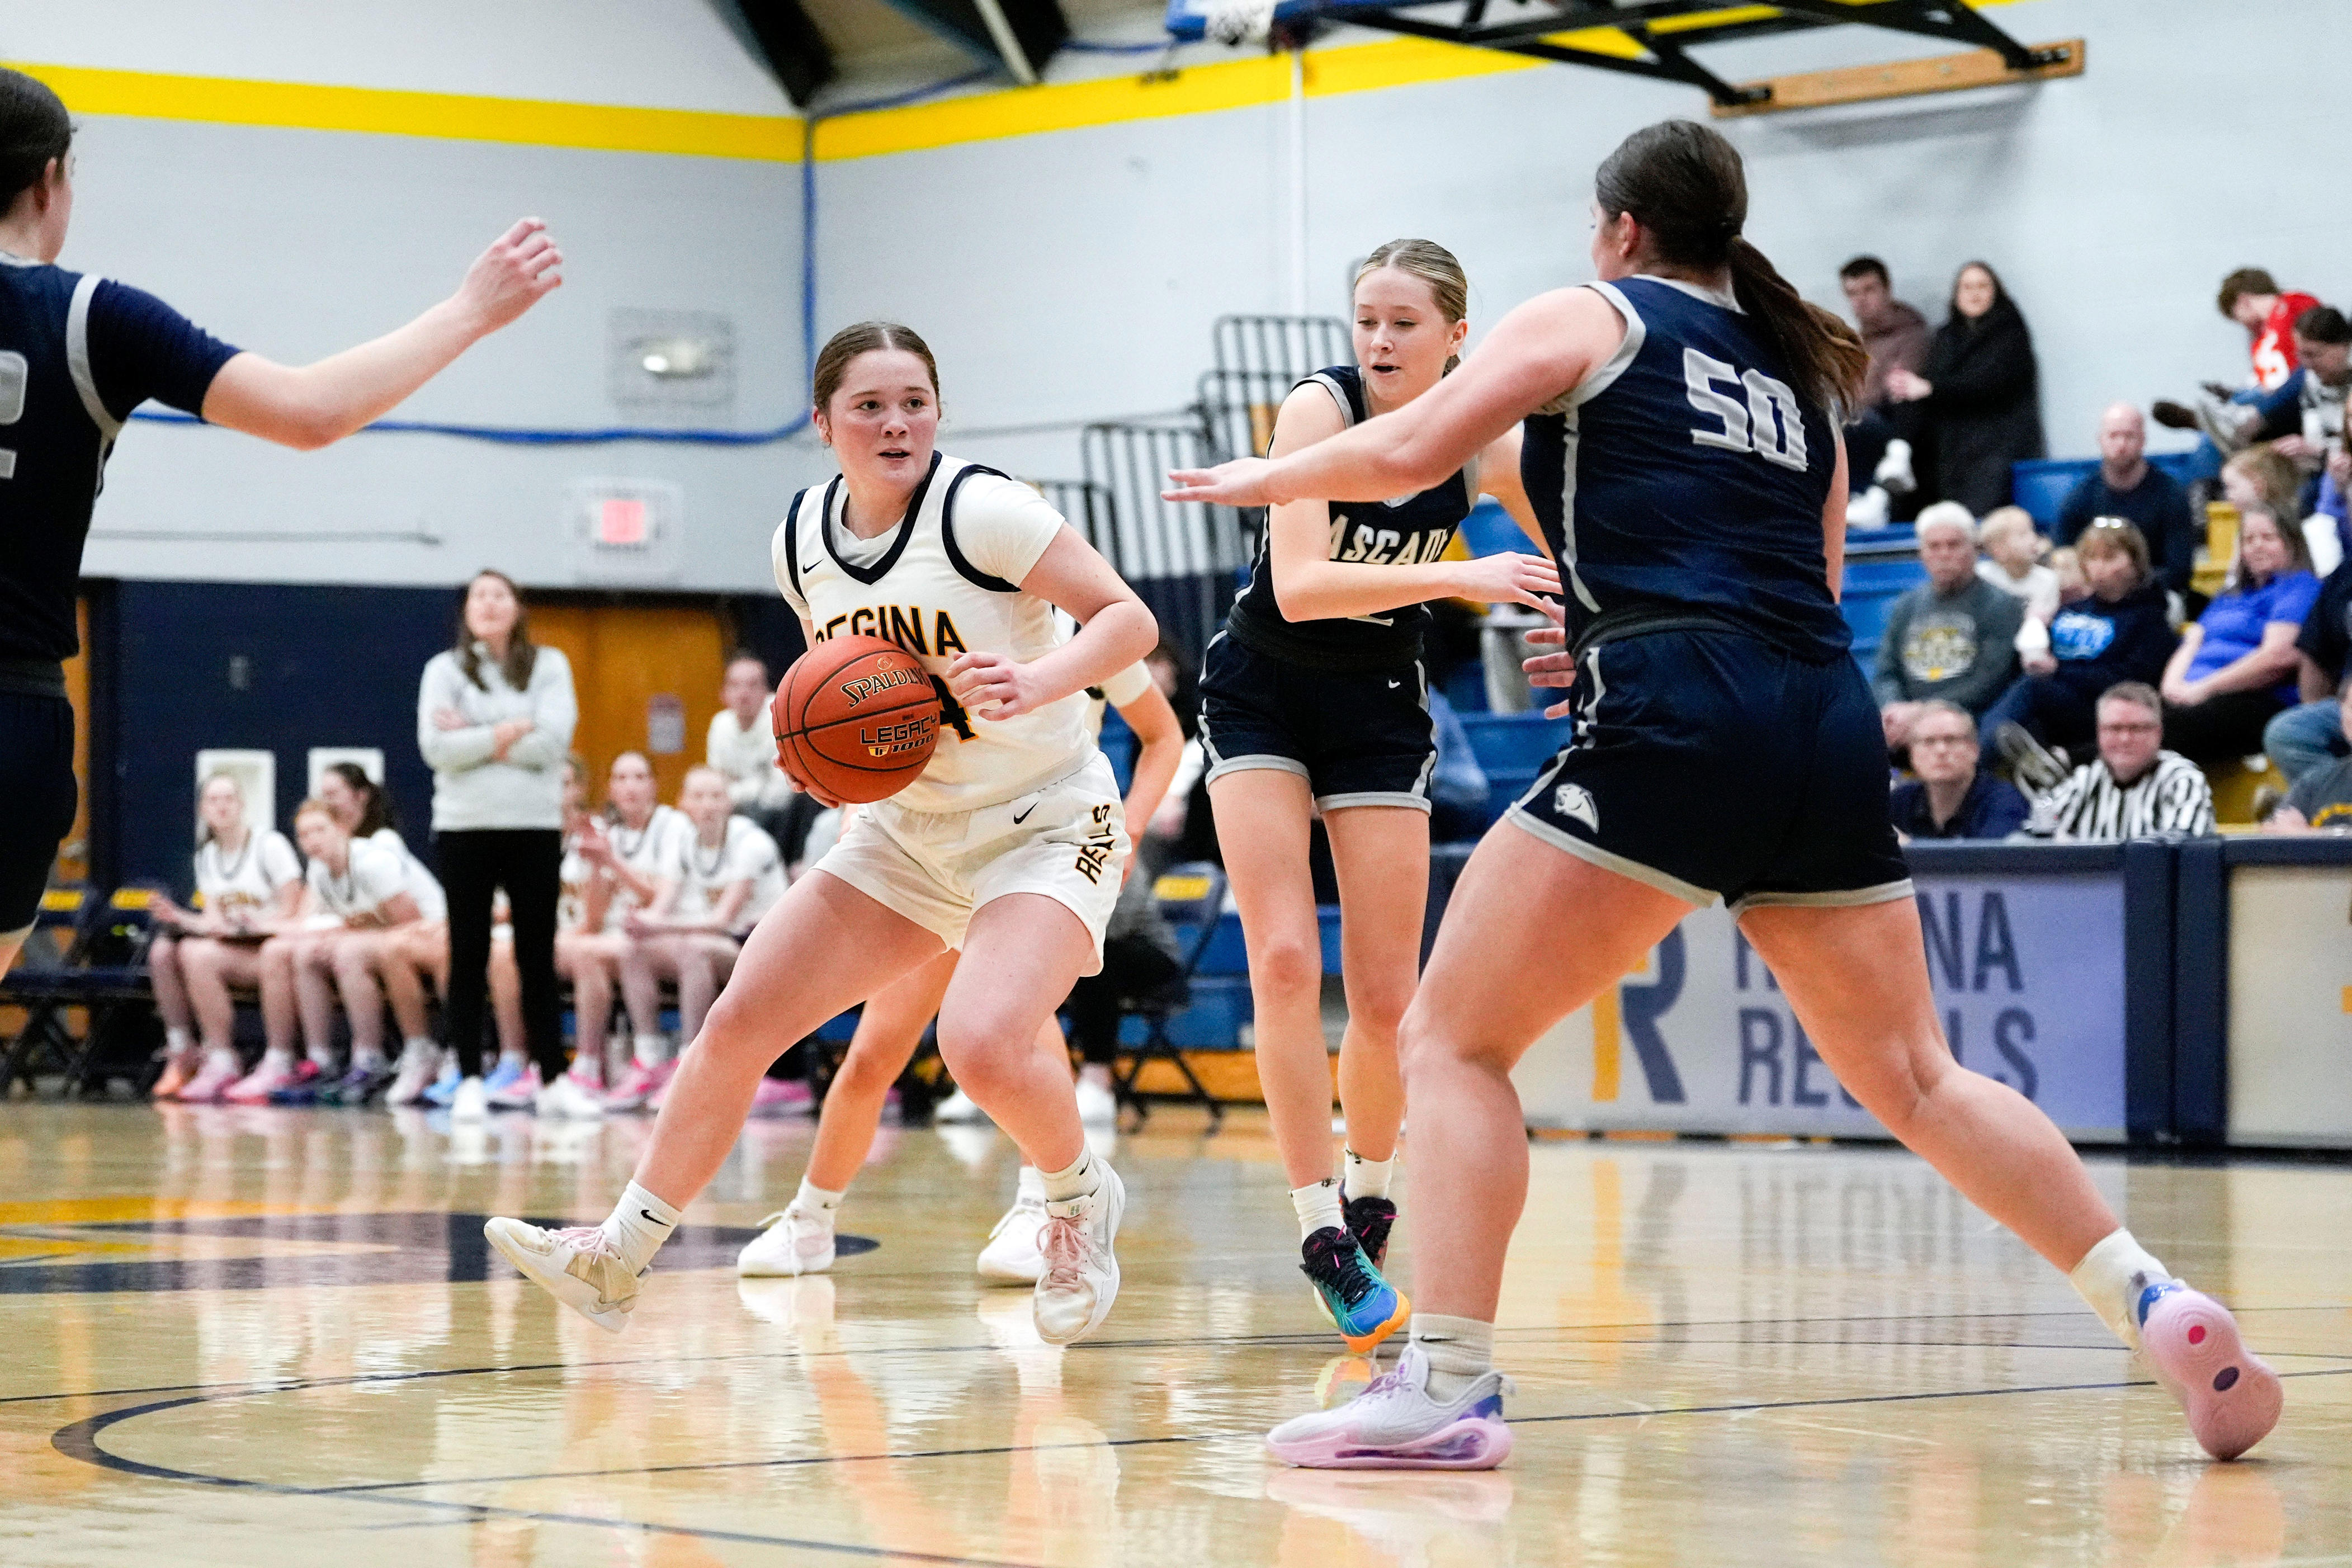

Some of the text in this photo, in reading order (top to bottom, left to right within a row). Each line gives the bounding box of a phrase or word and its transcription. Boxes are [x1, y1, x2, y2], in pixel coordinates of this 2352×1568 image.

[1683, 347, 1809, 472] 50
[1330, 513, 1449, 565] ASCAD
[815, 604, 969, 658] GINA
[840, 667, 932, 709] SPALDIN
[891, 734, 934, 753] 1000
